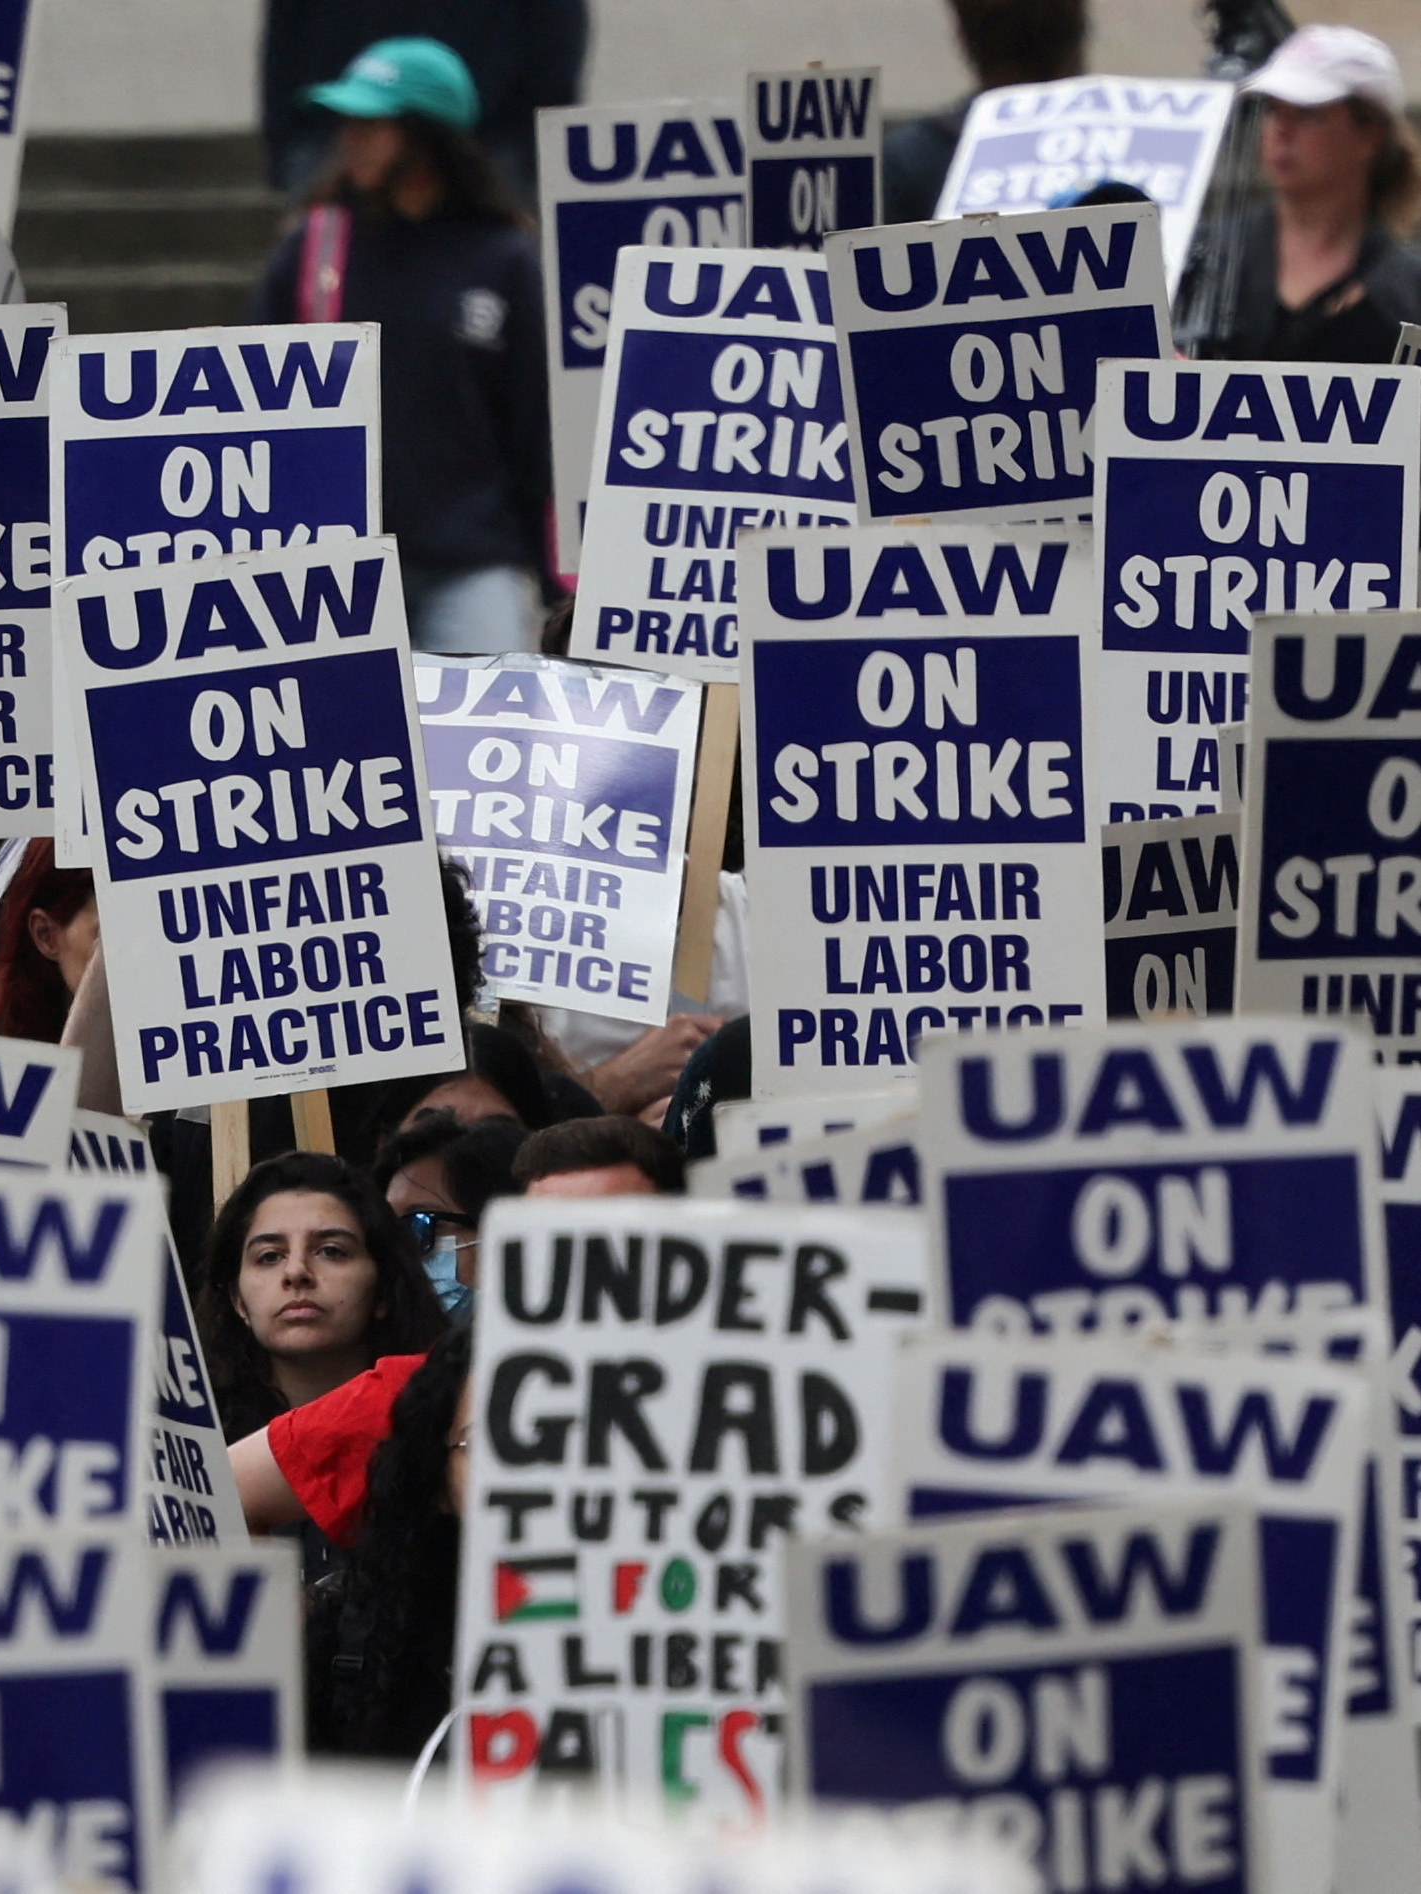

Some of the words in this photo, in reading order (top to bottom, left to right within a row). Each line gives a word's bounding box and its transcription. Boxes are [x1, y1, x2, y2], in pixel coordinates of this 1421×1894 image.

[755, 77, 874, 143] UAW
[1036, 125, 1130, 163] ON
[789, 165, 839, 235] ON
[853, 221, 1138, 312] UAW
[79, 340, 359, 420] UAW
[710, 343, 824, 409] ON
[949, 324, 1066, 403] ON
[619, 409, 849, 482] STRIK
[1123, 370, 1402, 445] UAW
[160, 440, 270, 518] ON
[878, 408, 1095, 494] STRIK
[1199, 471, 1309, 547] ON
[77, 558, 385, 669] UAW
[766, 541, 1070, 622] UAW
[596, 607, 739, 660] PRAC
[190, 677, 307, 762] ON
[857, 647, 978, 729] ON
[467, 737, 580, 789] ON
[770, 737, 1073, 824] STRIKE
[115, 757, 409, 860] STRIKE
[429, 790, 662, 860] TRIKE
[158, 862, 390, 944] UNFAIR
[452, 854, 623, 910] NFAIR
[810, 862, 1041, 924] UNFAIR
[1269, 855, 1421, 939] STR
[485, 899, 608, 951] BOR
[824, 933, 1031, 995] LABOR
[179, 931, 386, 1010] LABOR
[480, 943, 653, 1003] CTICE
[1133, 946, 1208, 1022] ON
[139, 990, 445, 1083] PRACTICE
[956, 1038, 1340, 1145] UAW
[1073, 1168, 1233, 1278] ON
[503, 1232, 921, 1341] UNDER-
[487, 1351, 862, 1475] GRAD
[936, 1364, 1339, 1482] UAW
[151, 1427, 213, 1496] FAIR
[147, 1493, 219, 1549] ABOR
[613, 1557, 763, 1615] FOR
[823, 1523, 1220, 1652] UAW
[474, 1641, 528, 1693] A
[562, 1632, 781, 1693] LIBER
[944, 1665, 1112, 1786] ON
